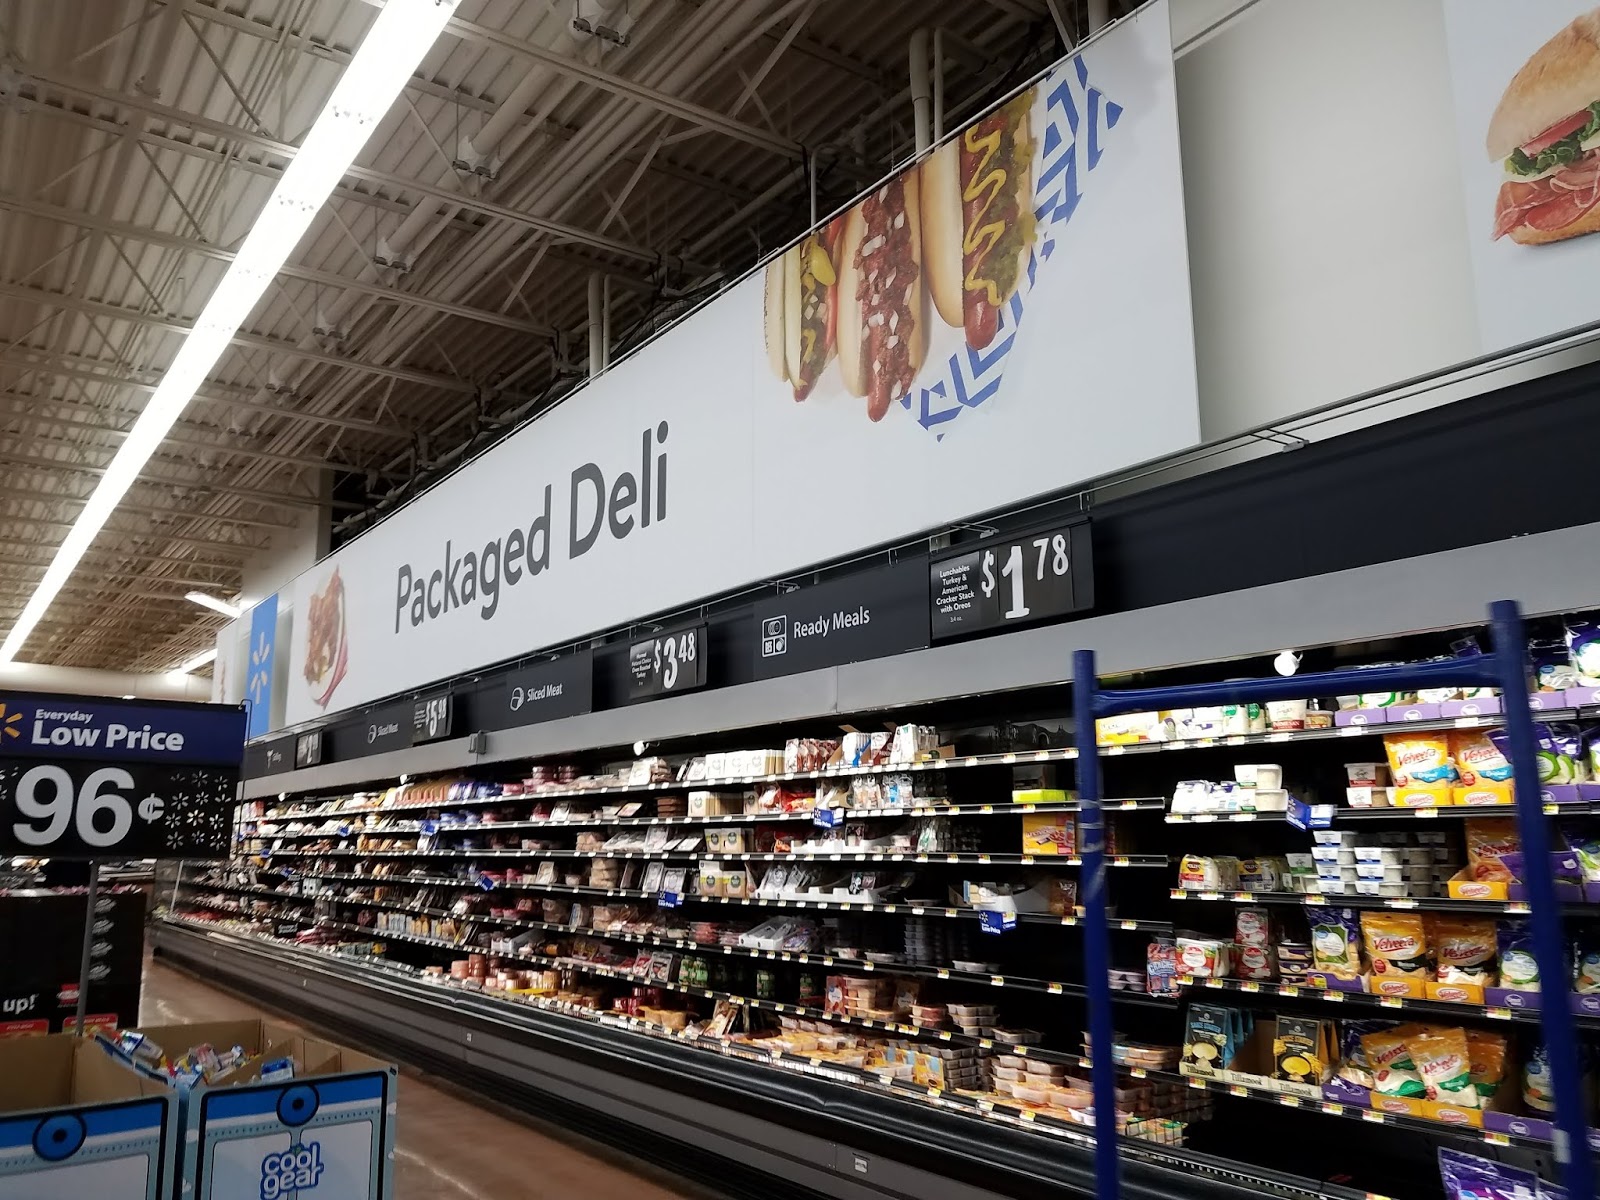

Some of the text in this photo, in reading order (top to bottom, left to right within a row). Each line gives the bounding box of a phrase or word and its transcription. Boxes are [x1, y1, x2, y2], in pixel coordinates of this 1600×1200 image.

[395, 420, 669, 634] Packaged Deli
[939, 565, 970, 578] Lunchables
[942, 573, 967, 586] Turkey &
[942, 584, 968, 595] American
[936, 590, 975, 606] Cracker Stack
[940, 602, 971, 614] with Oreos
[793, 605, 870, 639] Ready Meals
[526, 683, 563, 703] Sliced Meat
[35, 709, 94, 724] Everyday
[31, 719, 185, 751] Low Price
[1374, 938, 1415, 951] Velveeta
[3, 993, 39, 1015] up!
[1231, 1073, 1262, 1086] Tillamook
[1279, 1083, 1312, 1096] Tillamook
[264, 1144, 318, 1175] cool
[263, 1166, 321, 1200] gear
